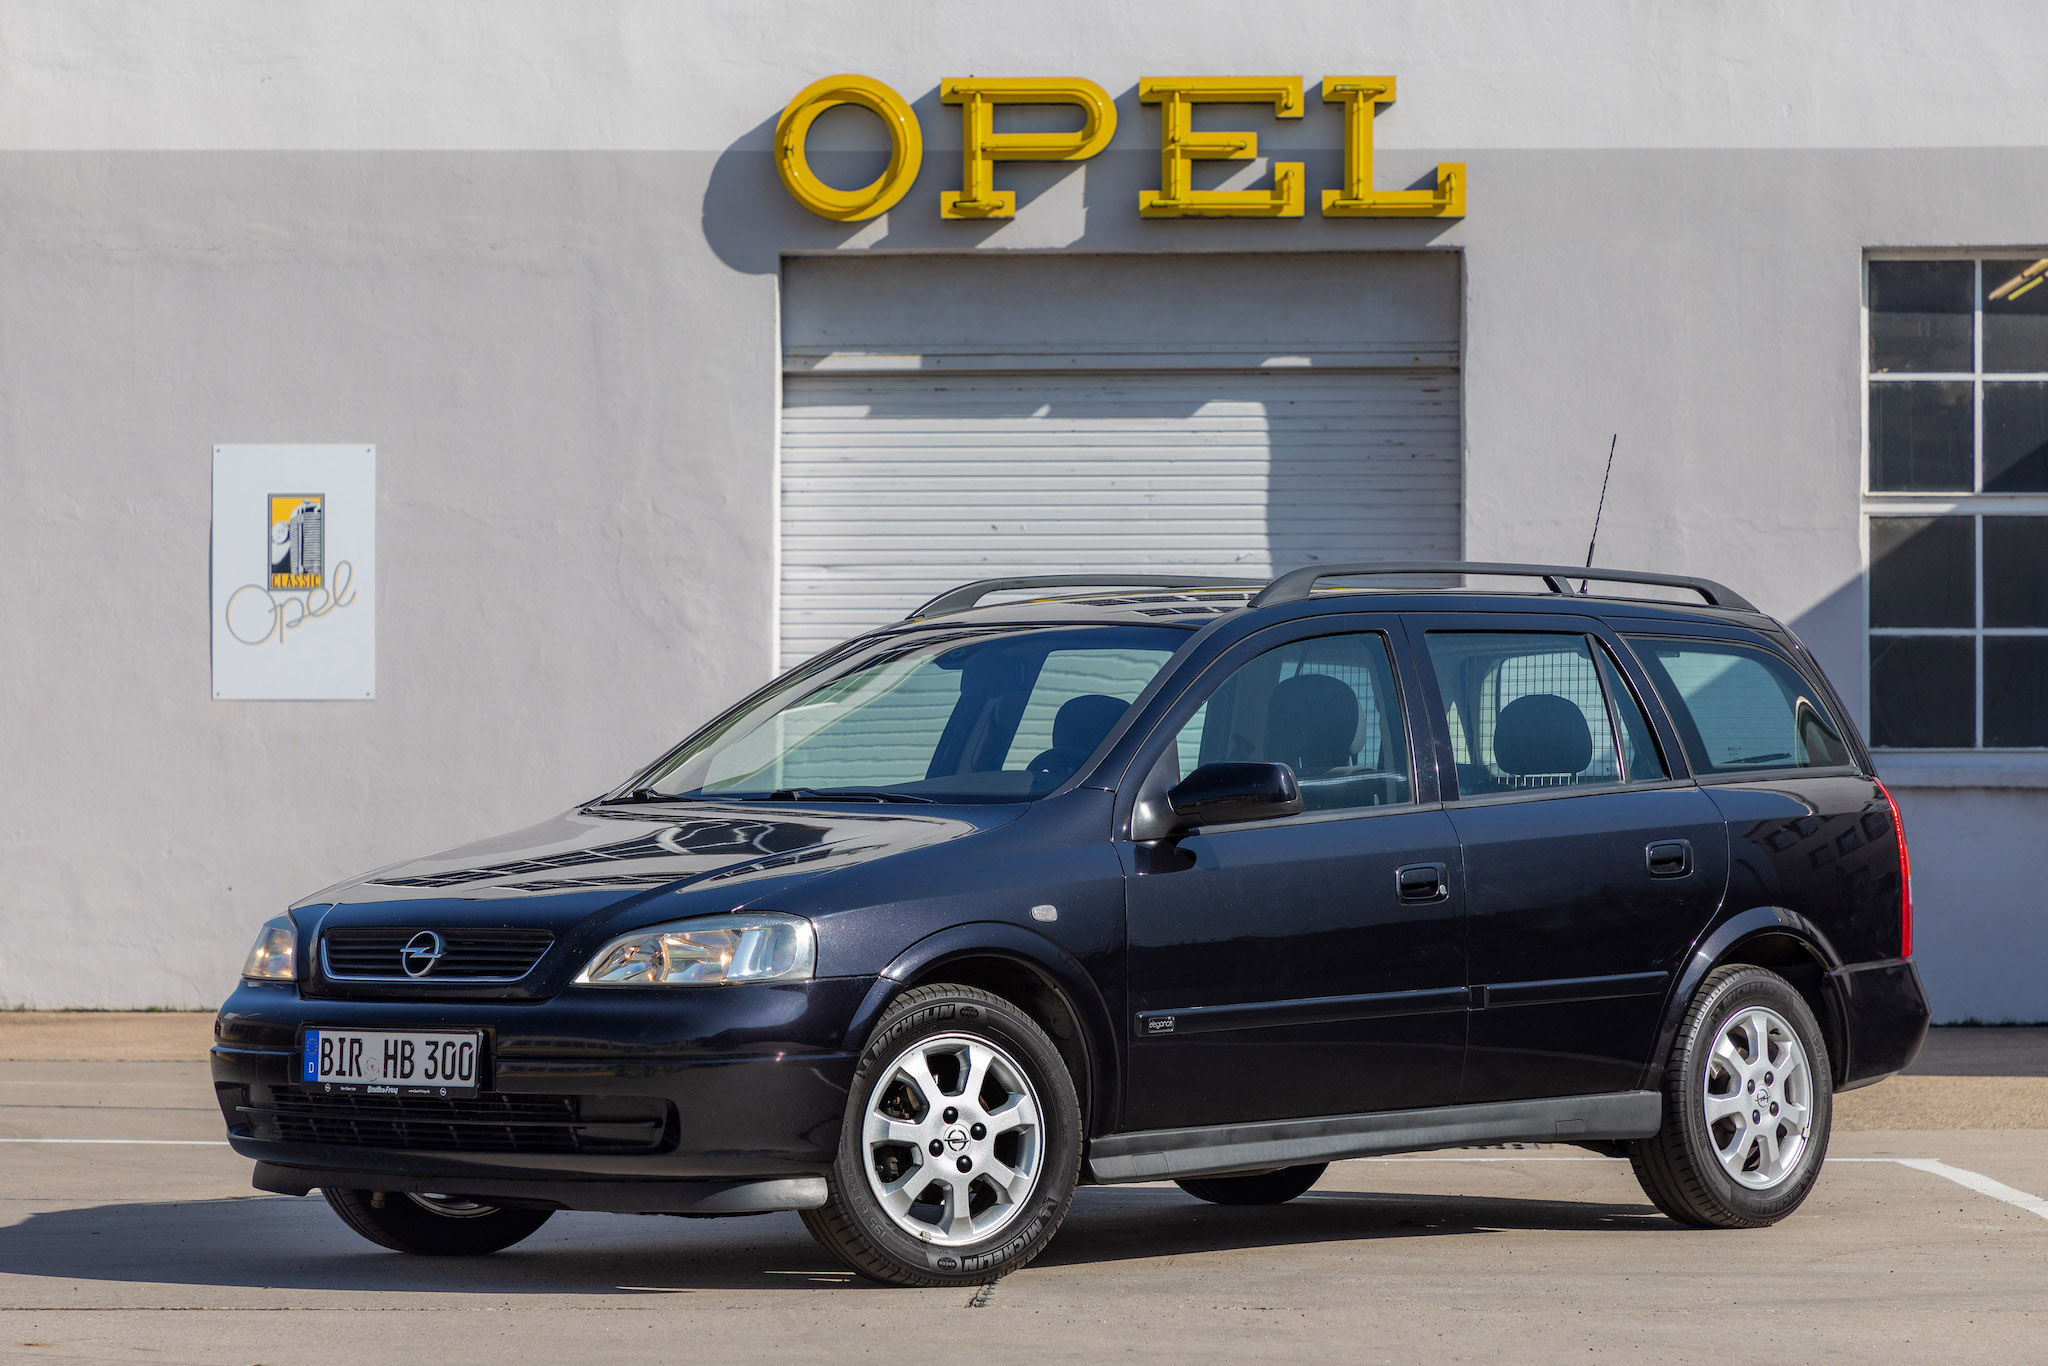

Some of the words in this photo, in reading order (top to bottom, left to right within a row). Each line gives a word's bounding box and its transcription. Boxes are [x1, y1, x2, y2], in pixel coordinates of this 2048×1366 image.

[774, 74, 1466, 222] OPEL
[226, 560, 356, 645] Opel
[272, 574, 320, 588] CLASSIC
[871, 1003, 955, 1058] MICHELIN
[307, 1061, 315, 1074] D
[320, 1037, 363, 1078] BIR
[383, 1038, 415, 1079] HB
[424, 1040, 473, 1081] 300
[962, 1218, 1044, 1273] MICHELIN
